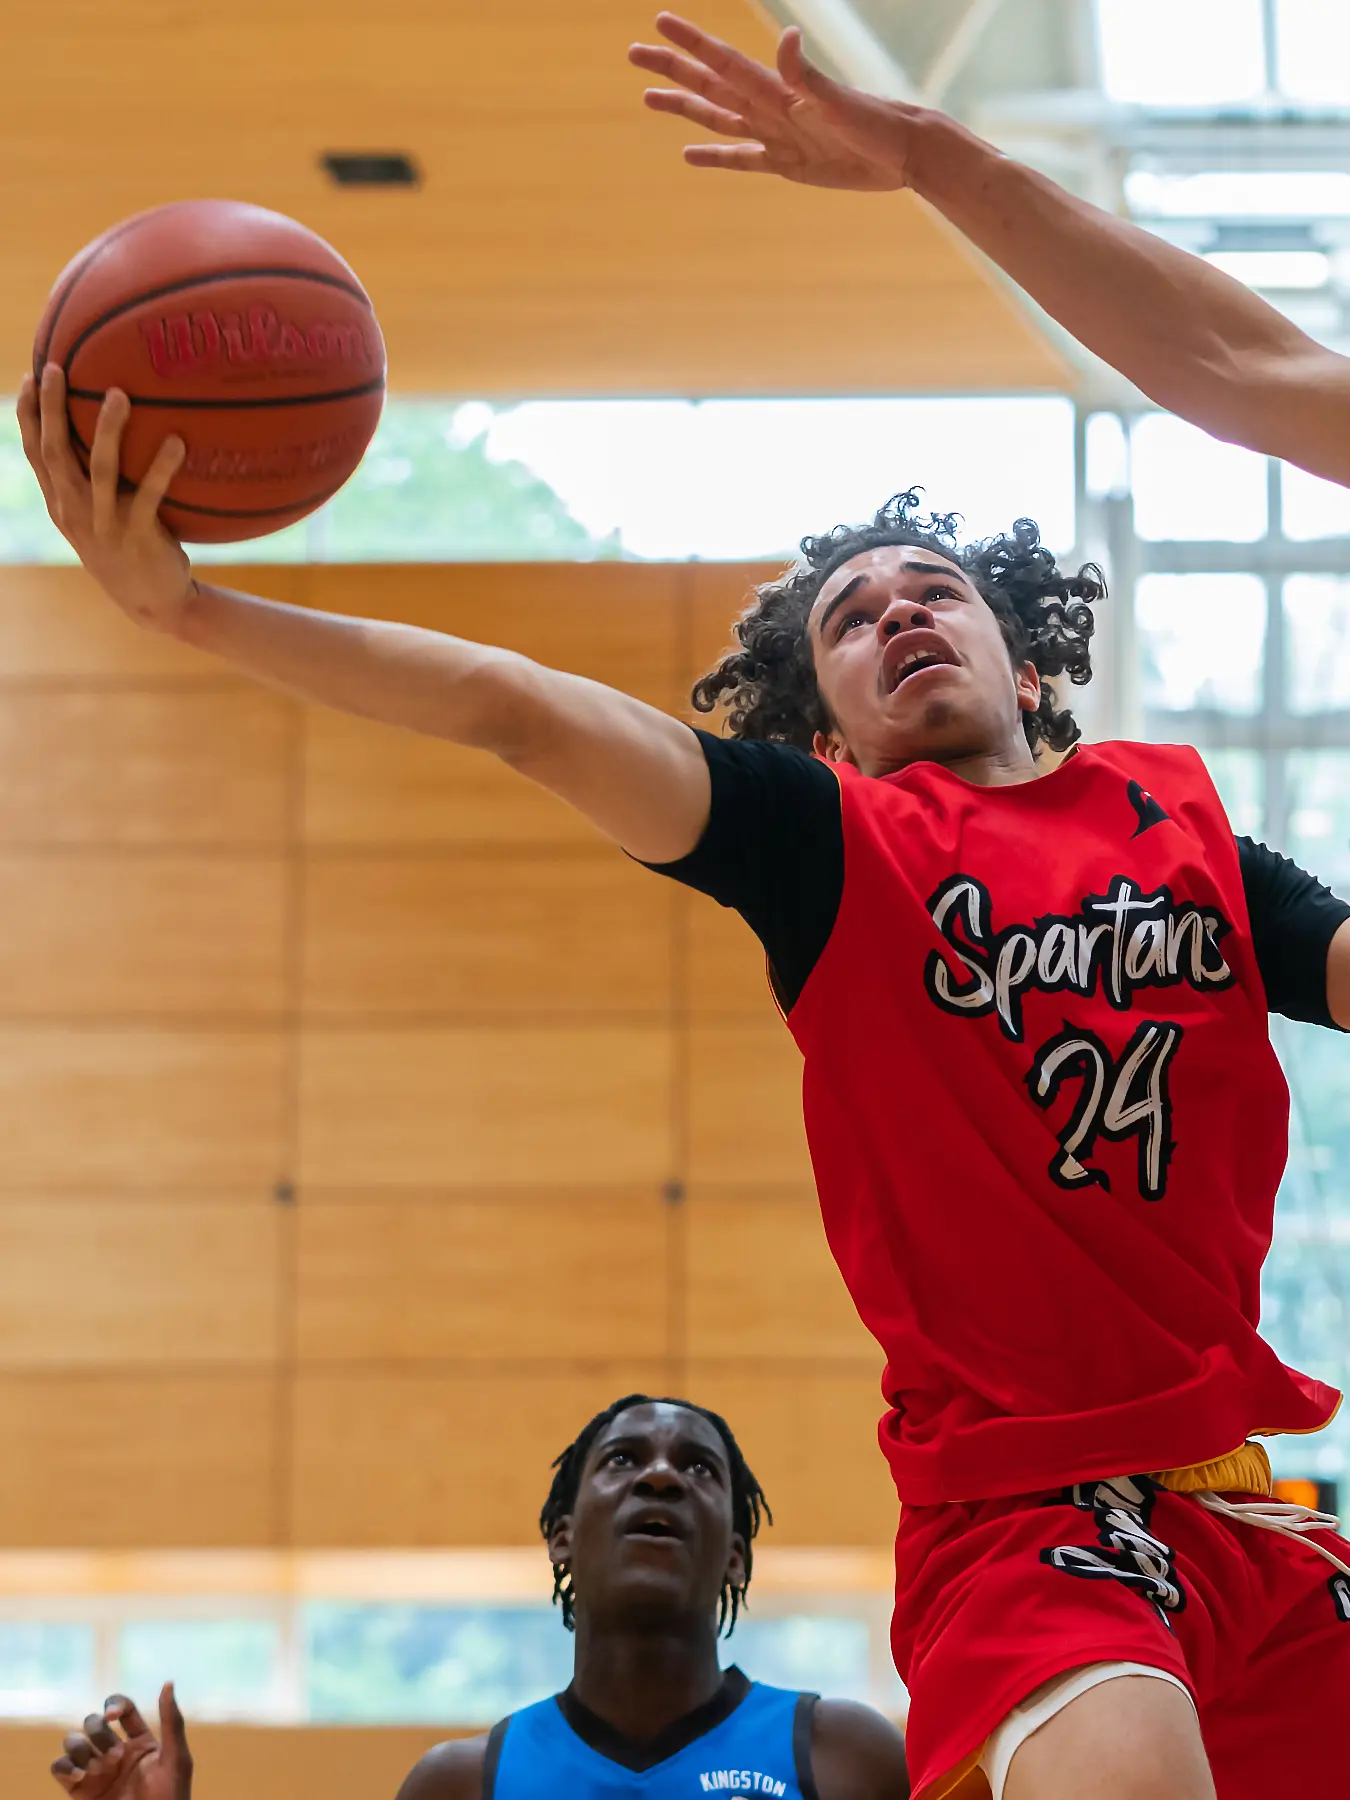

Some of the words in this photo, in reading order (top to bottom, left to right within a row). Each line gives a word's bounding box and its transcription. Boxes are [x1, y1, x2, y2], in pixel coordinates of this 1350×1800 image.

[143, 303, 372, 377] Wilson
[928, 877, 1233, 1038] Spartans
[1029, 1023, 1181, 1197] 24
[699, 1769, 787, 1797] KINGSTON
